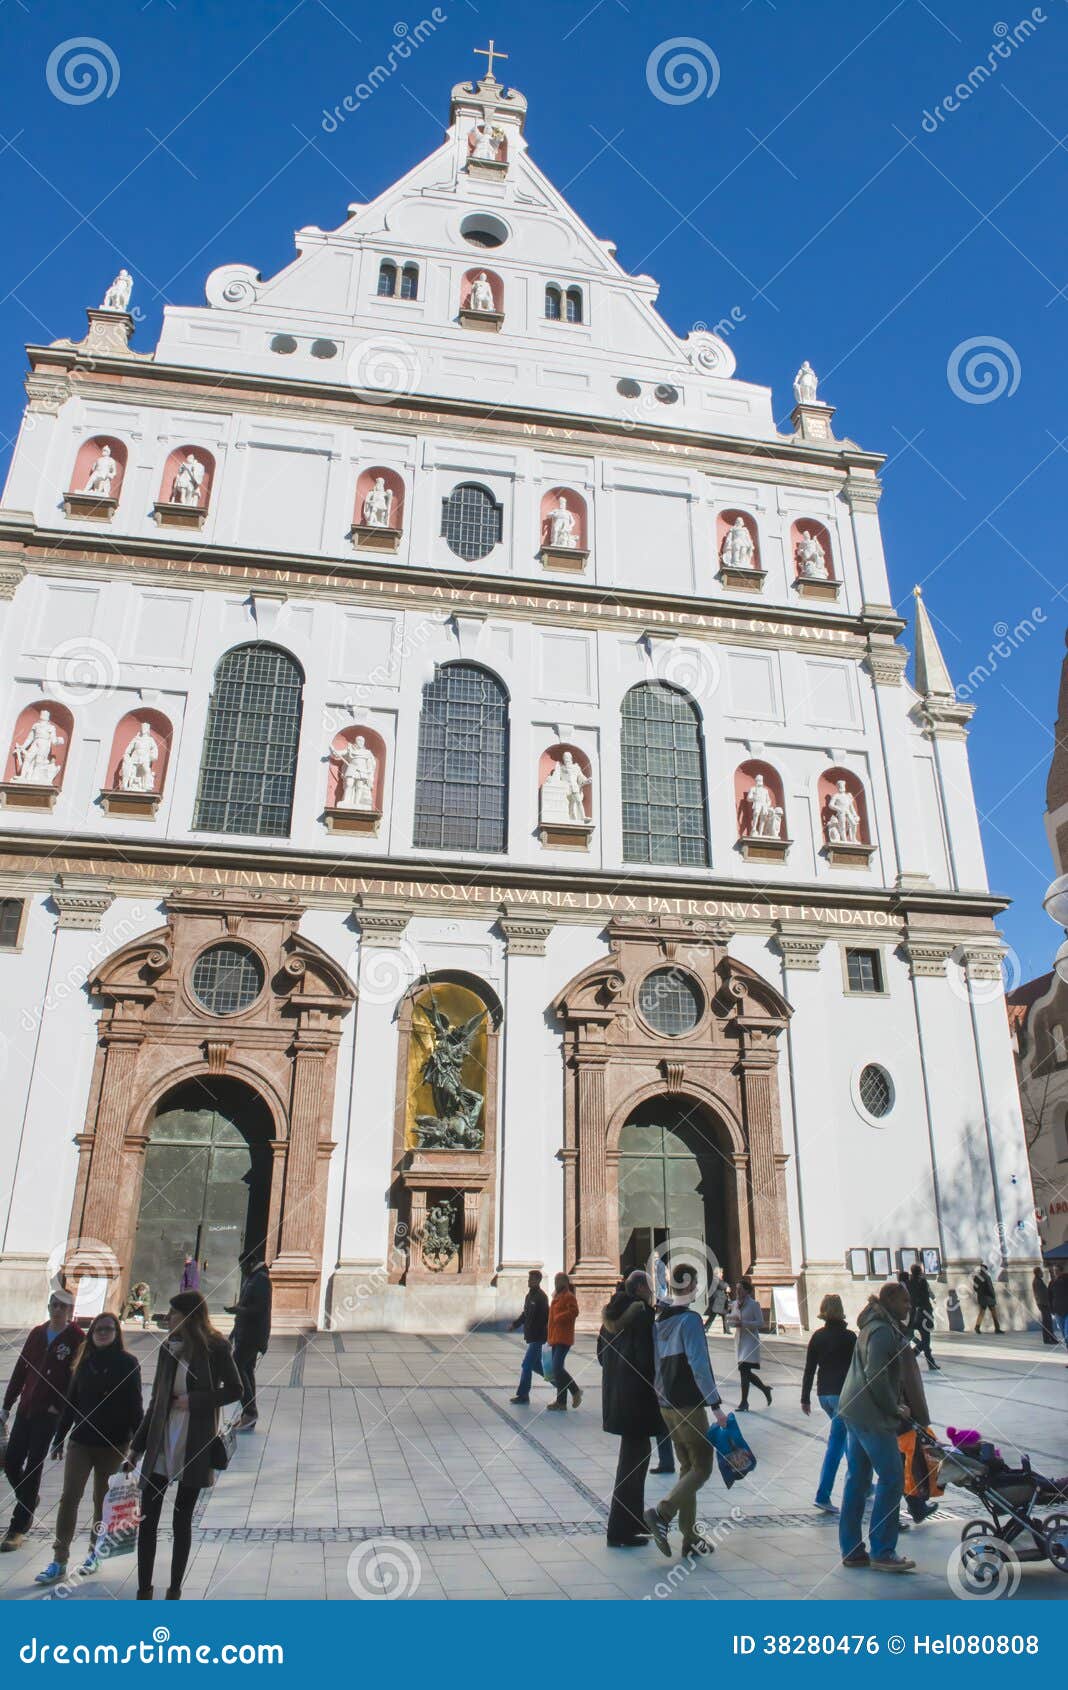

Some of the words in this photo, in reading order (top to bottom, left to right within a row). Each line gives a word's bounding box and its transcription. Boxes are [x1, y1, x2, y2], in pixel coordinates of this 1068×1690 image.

[522, 423, 574, 439] MAX
[616, 605, 737, 630] DEDICARI
[749, 619, 850, 642] CVRAVIT
[585, 892, 638, 911] DVX
[647, 896, 763, 920] PATRONVS
[769, 904, 797, 920] ET
[800, 905, 903, 927] FVNDATOR
